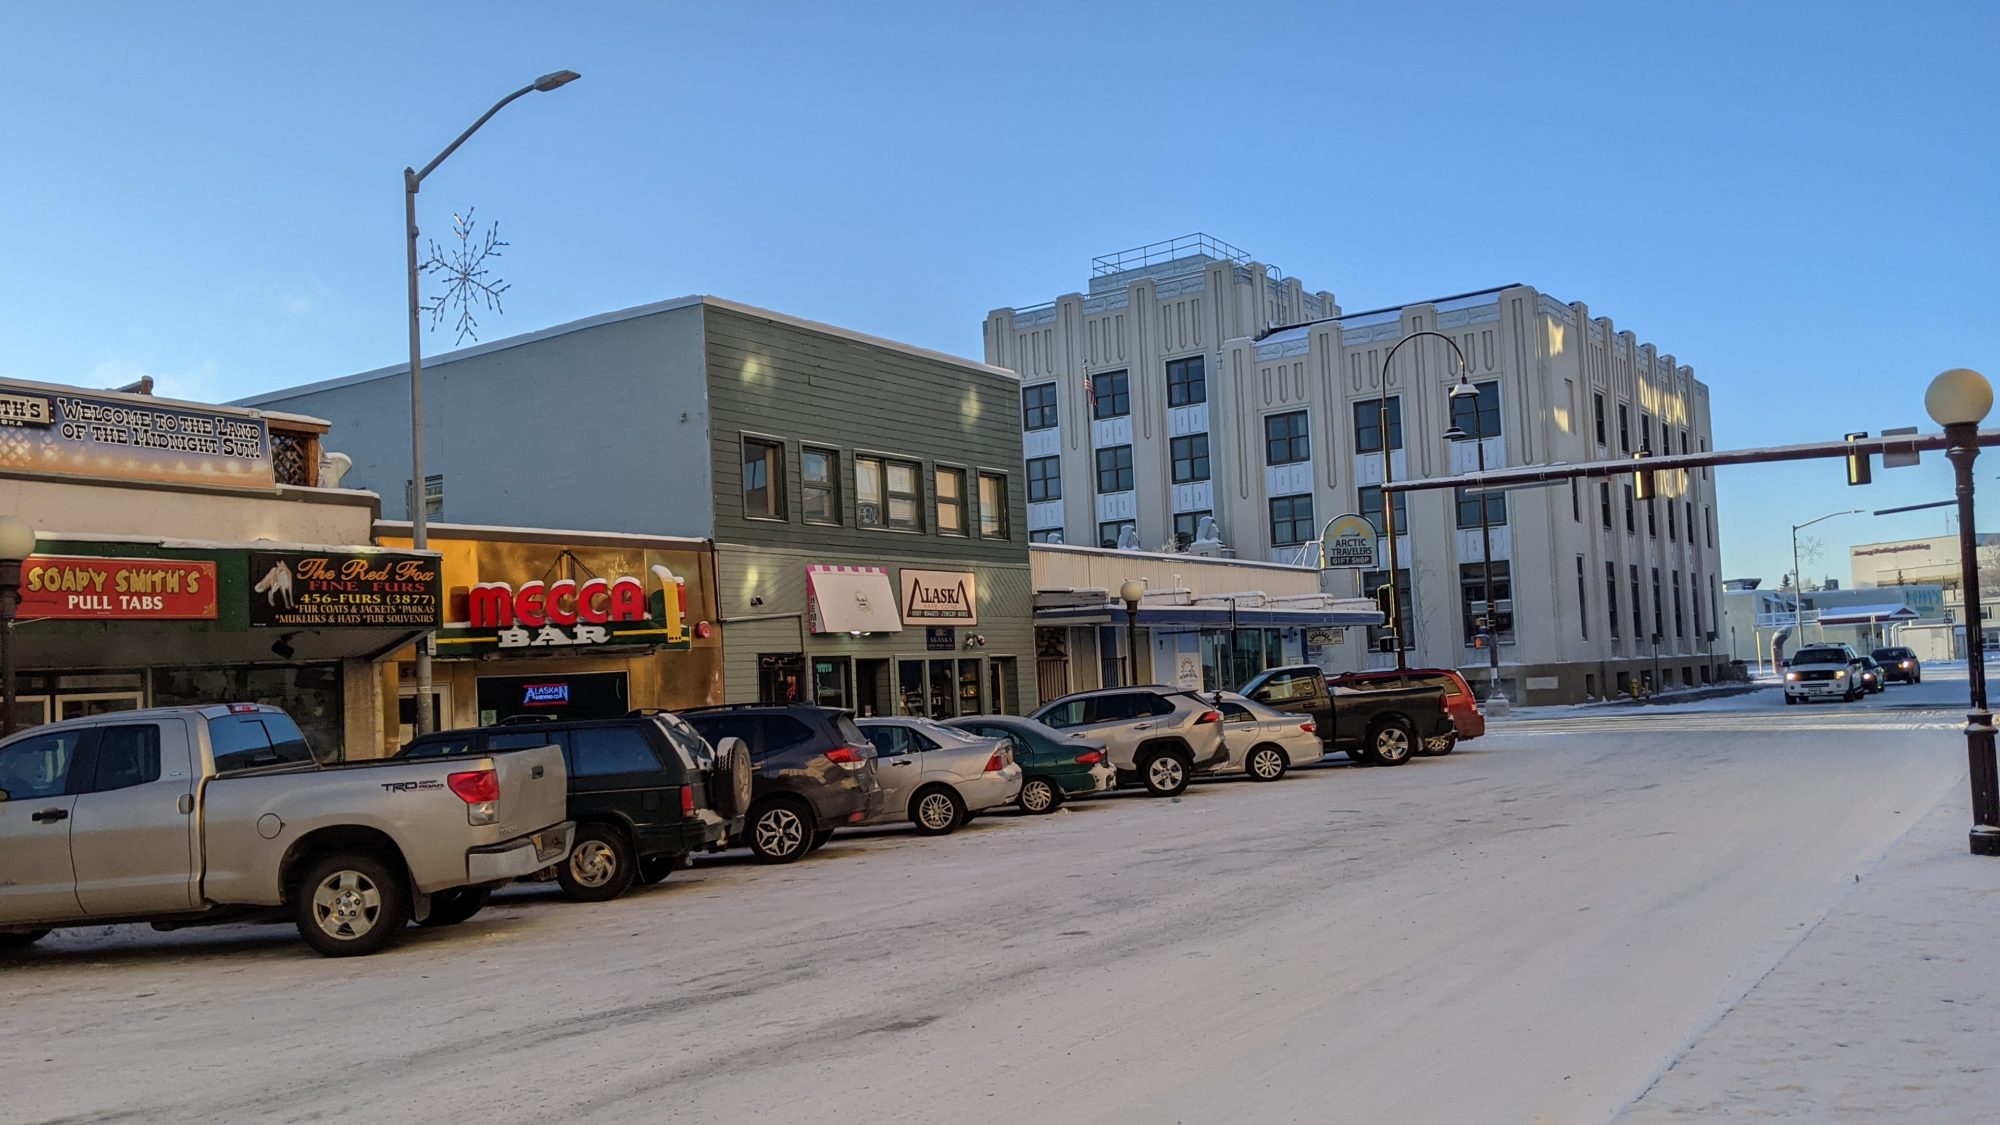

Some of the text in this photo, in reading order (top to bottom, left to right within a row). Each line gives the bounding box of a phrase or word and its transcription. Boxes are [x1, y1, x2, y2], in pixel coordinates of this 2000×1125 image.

[0, 399, 41, 418] TH'S
[58, 398, 260, 440] WELCOME TO THE LAND
[62, 422, 261, 459] OF THE MIDNIGHT SUN!
[1331, 547, 1372, 556] TRAVELERS
[1335, 539, 1367, 548] ARCTIC
[296, 558, 434, 581] The Red Fox
[27, 565, 201, 594] SOAPY SMITH'S
[309, 581, 425, 593] FINE FURS
[68, 595, 163, 610] PULL TABS
[300, 593, 435, 605] 456-FURS (3877)
[469, 577, 645, 628] MECCA
[906, 577, 973, 618] ALASKA
[320, 604, 349, 614] COATS
[350, 605, 358, 614] &
[359, 605, 396, 614] JACKETS
[328, 615, 336, 623] &
[337, 615, 361, 623] HATS
[386, 615, 434, 624] SOUVENIRS
[498, 625, 611, 648] BAR
[523, 685, 568, 703] ALASKAN
[381, 782, 418, 792] TRD
